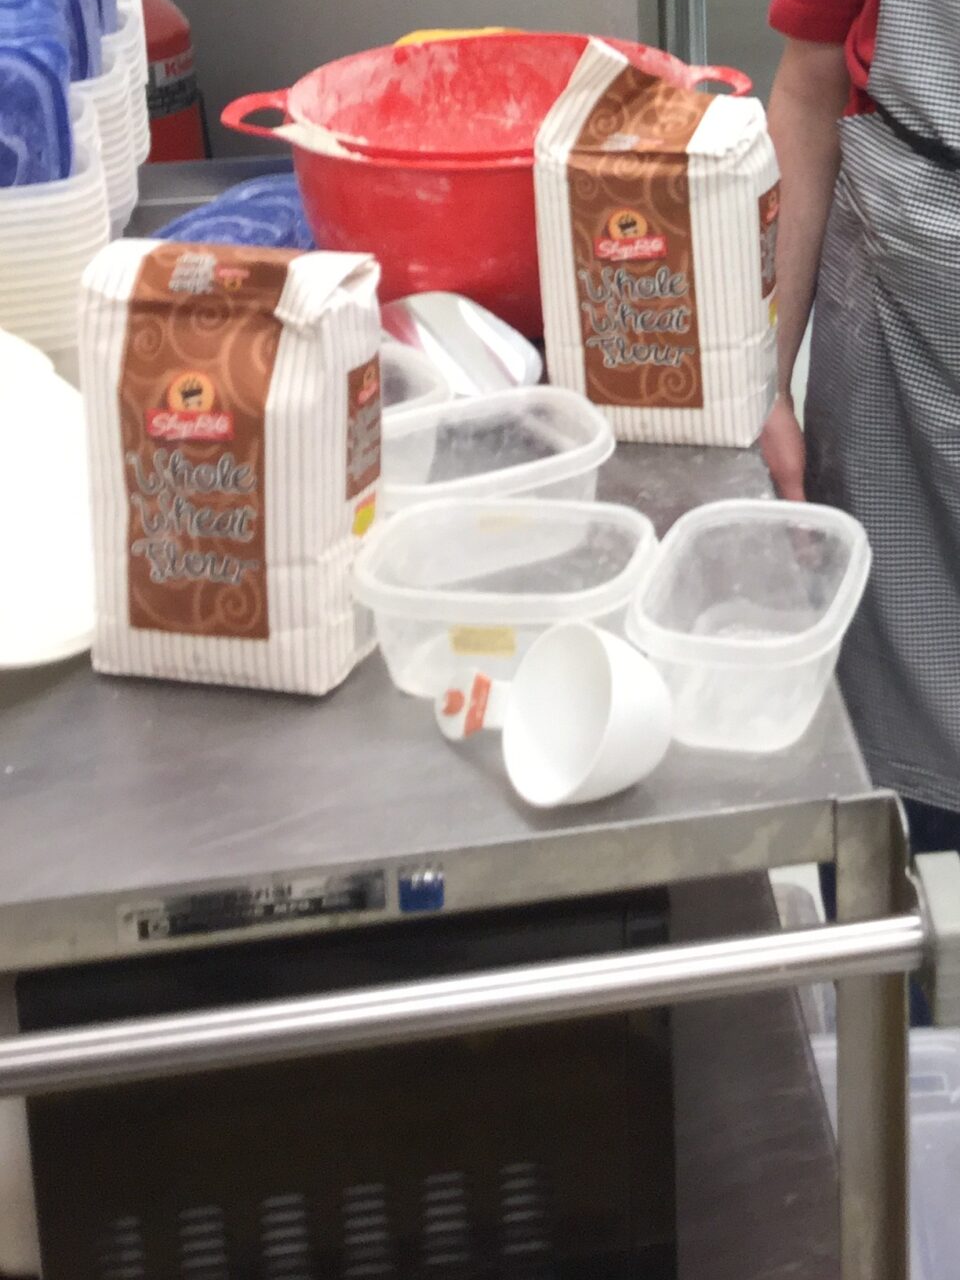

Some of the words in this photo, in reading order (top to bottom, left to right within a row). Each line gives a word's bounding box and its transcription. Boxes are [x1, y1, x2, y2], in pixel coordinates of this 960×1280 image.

[577, 266, 690, 301] Whole
[581, 298, 692, 334] Wheat
[585, 335, 695, 368] Flour
[125, 448, 257, 494] Whole
[130, 490, 257, 543] Wheat
[131, 538, 259, 584] Flour
